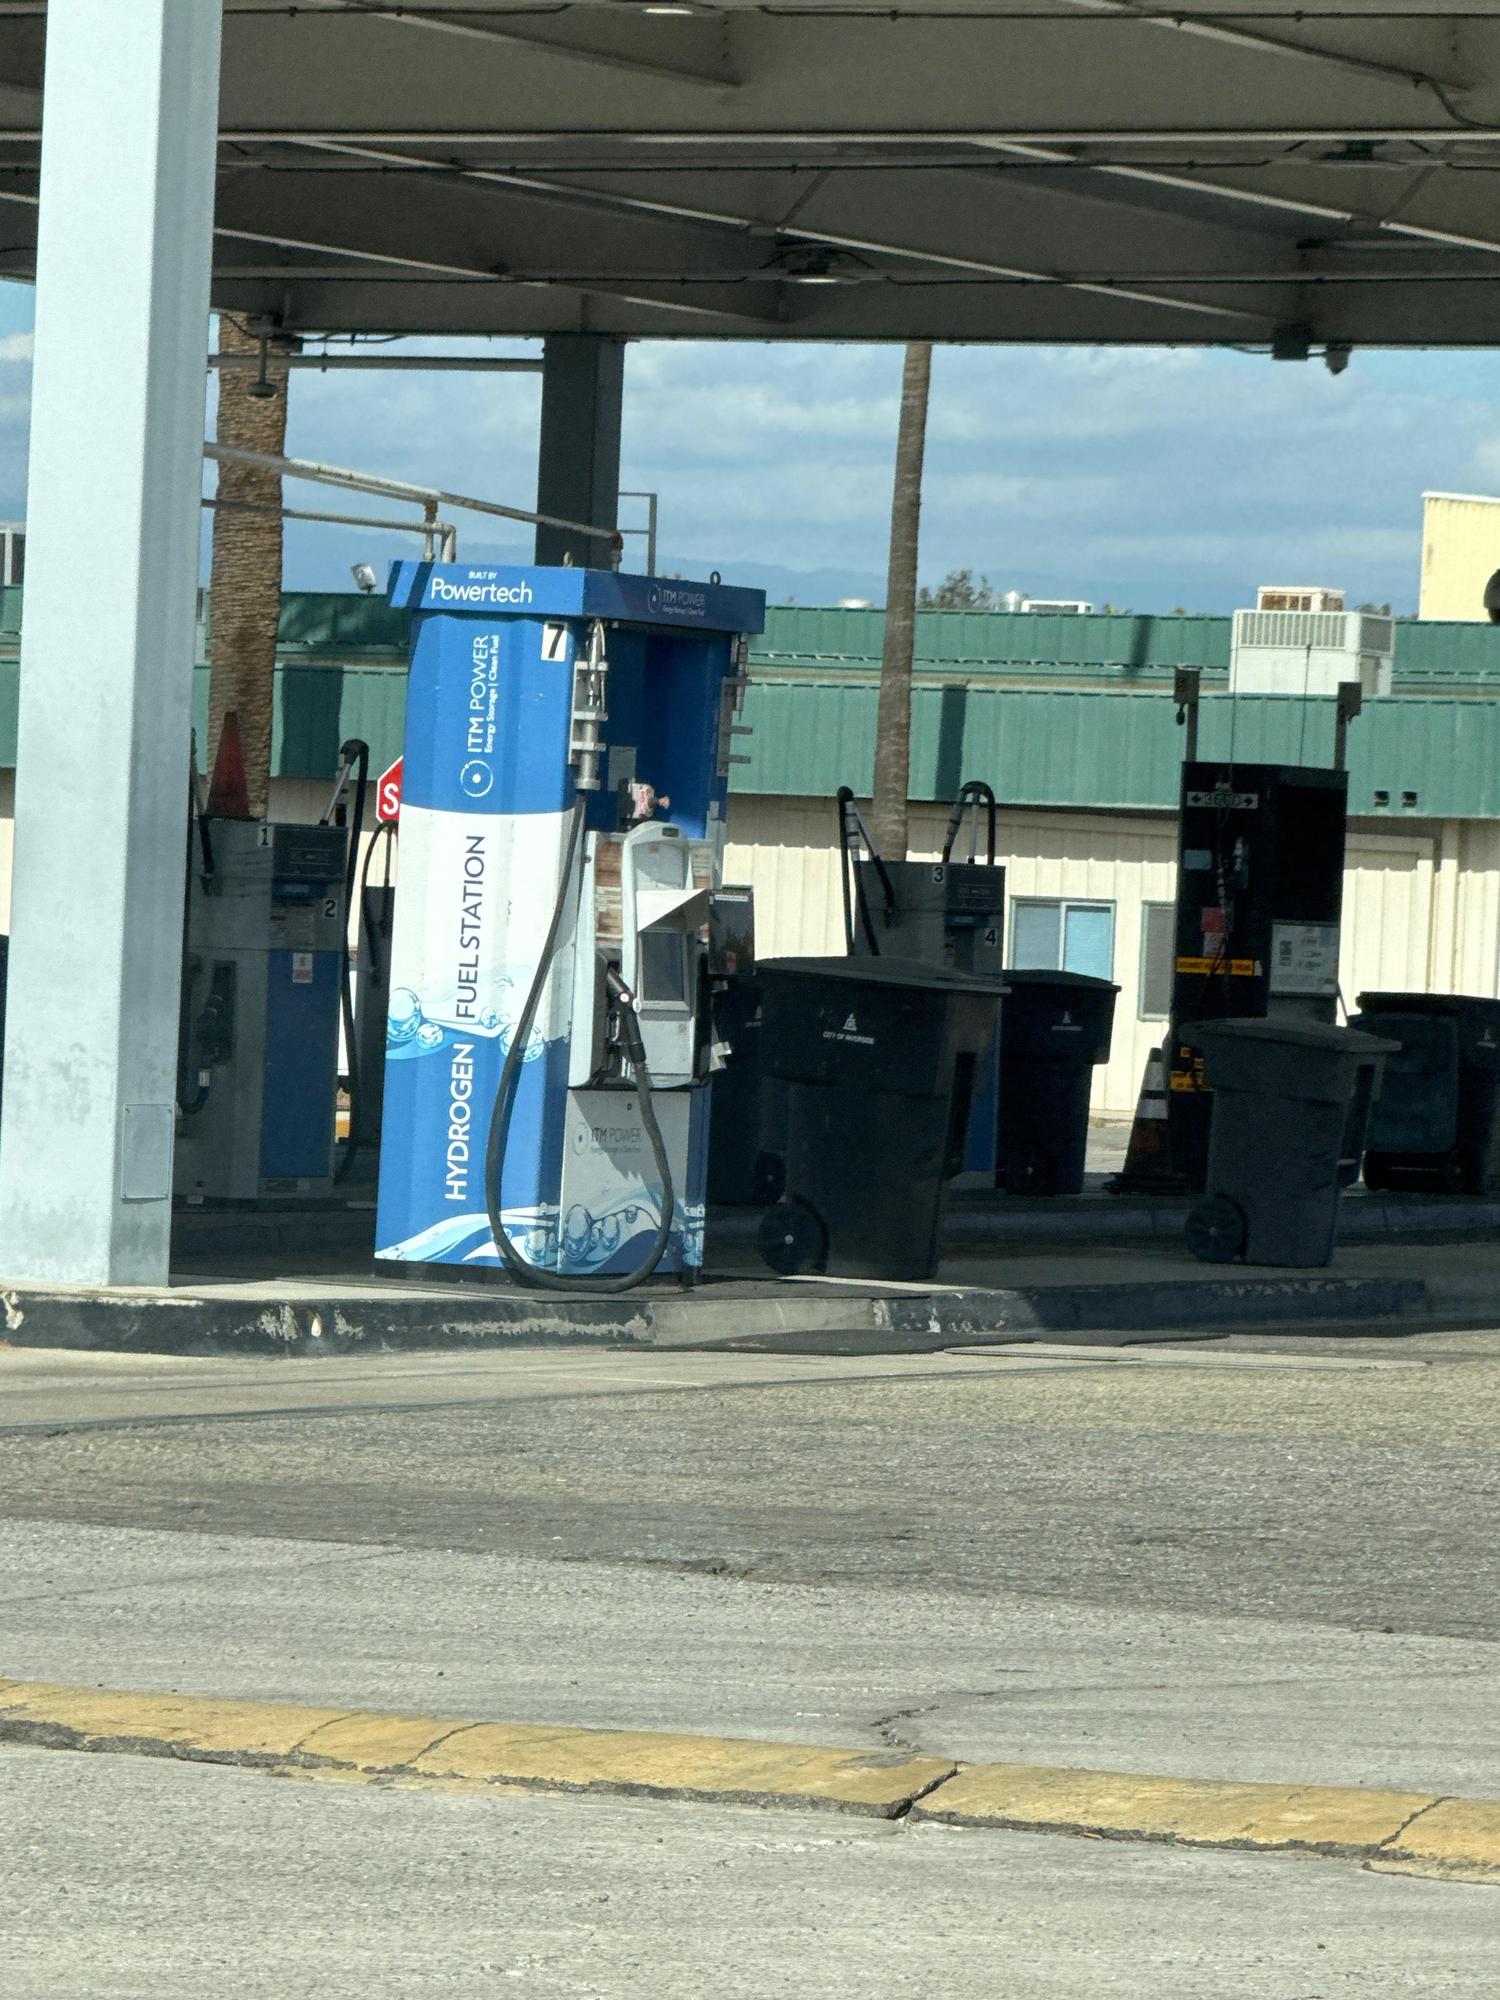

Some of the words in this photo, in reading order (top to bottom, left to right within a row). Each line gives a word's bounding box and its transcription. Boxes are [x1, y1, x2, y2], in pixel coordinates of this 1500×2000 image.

[469, 571, 487, 579] BUILT
[488, 572, 498, 580] BY
[431, 577, 533, 604] Powertech
[490, 635, 499, 654] Fuel
[547, 623, 564, 659] 7
[470, 635, 489, 710] POWER
[488, 656, 498, 681] Clean
[486, 689, 498, 722] Storage
[467, 717, 484, 753] ITM
[484, 724, 496, 753] Energy
[260, 828, 269, 846] 1
[934, 867, 943, 882] 3
[324, 899, 336, 918] 2
[986, 929, 996, 945] 4
[444, 1043, 475, 1201] HYDROGEN
[591, 1127, 607, 1143] ITM
[608, 1127, 641, 1143] POWER
